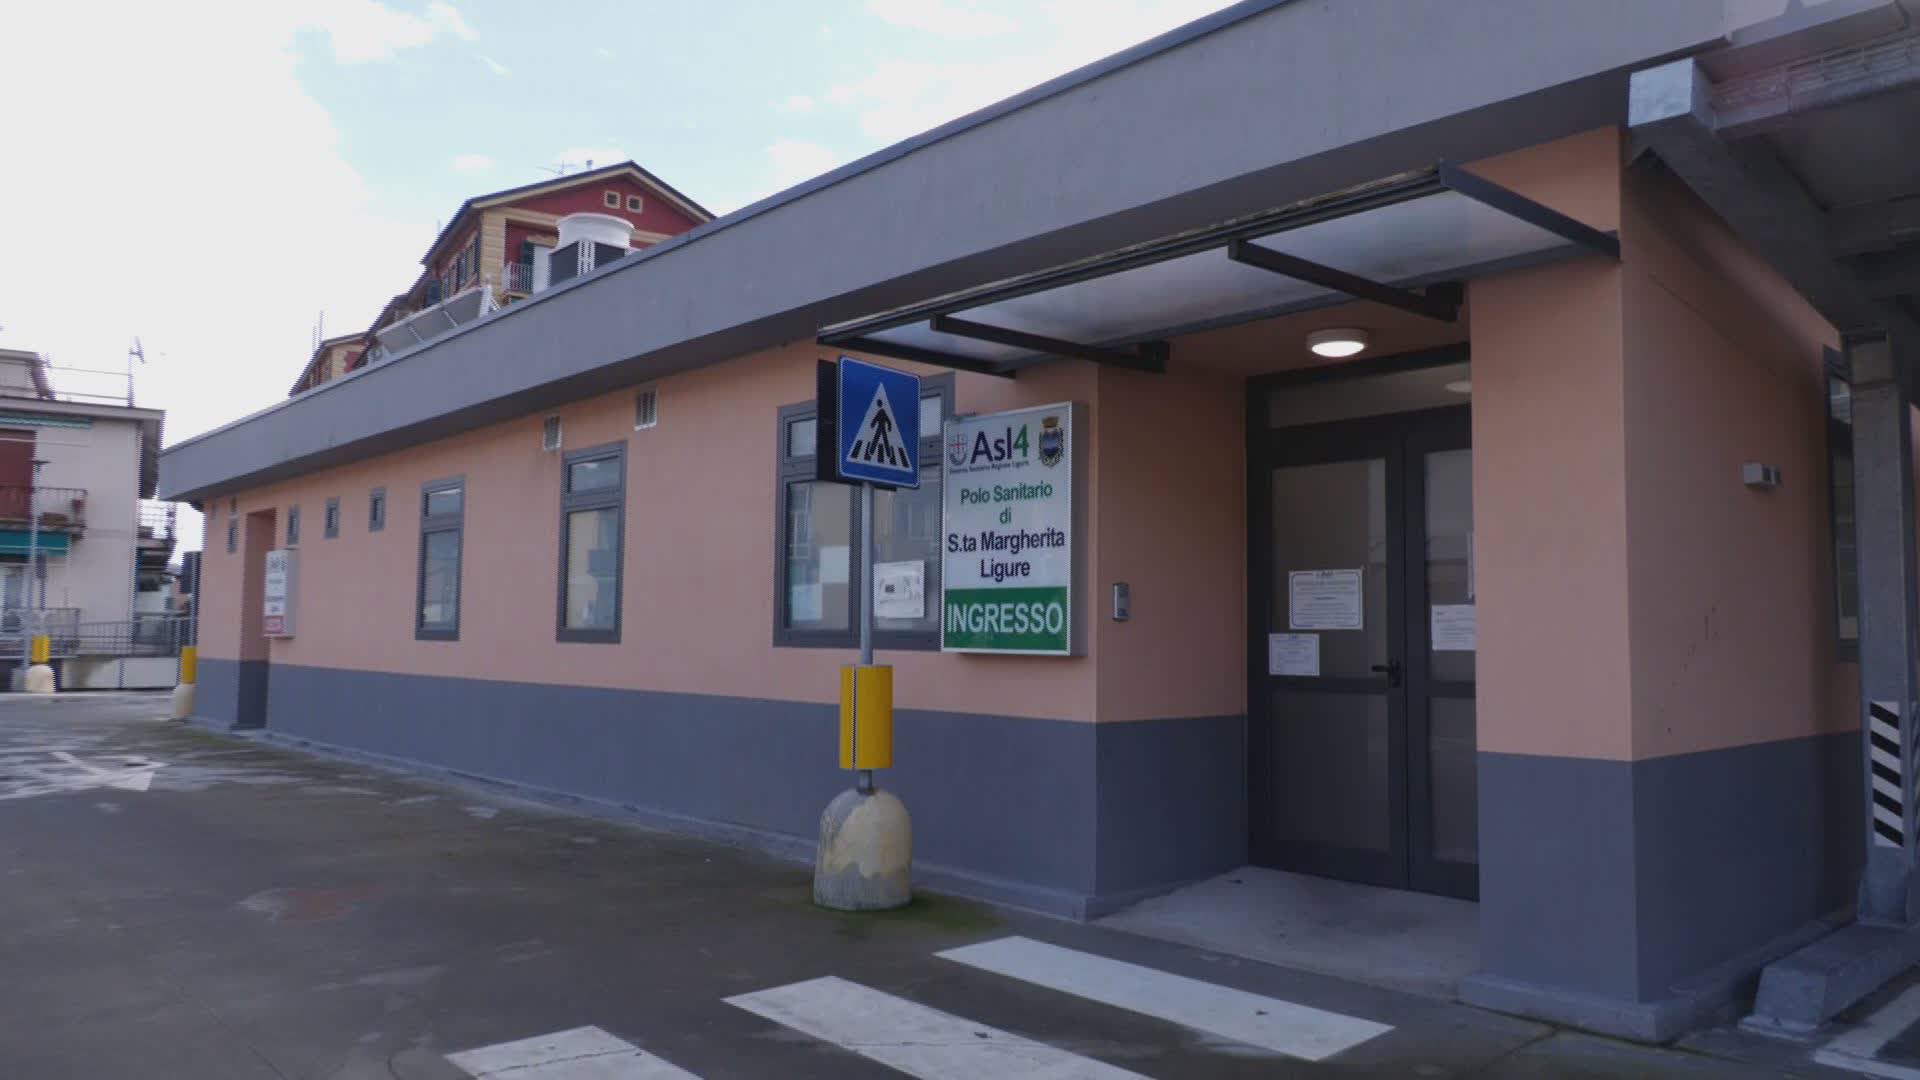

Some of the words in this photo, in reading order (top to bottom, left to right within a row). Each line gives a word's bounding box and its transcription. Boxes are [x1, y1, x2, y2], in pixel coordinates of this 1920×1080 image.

[970, 423, 1029, 464] Asl4
[960, 487, 991, 505] Polo
[993, 480, 1053, 503] Sanitario
[999, 506, 1012, 524] di
[948, 532, 977, 553] S.ta
[981, 527, 1065, 555] Margherita
[980, 558, 1031, 583] Ligure
[947, 601, 1064, 634] INGRESSO
